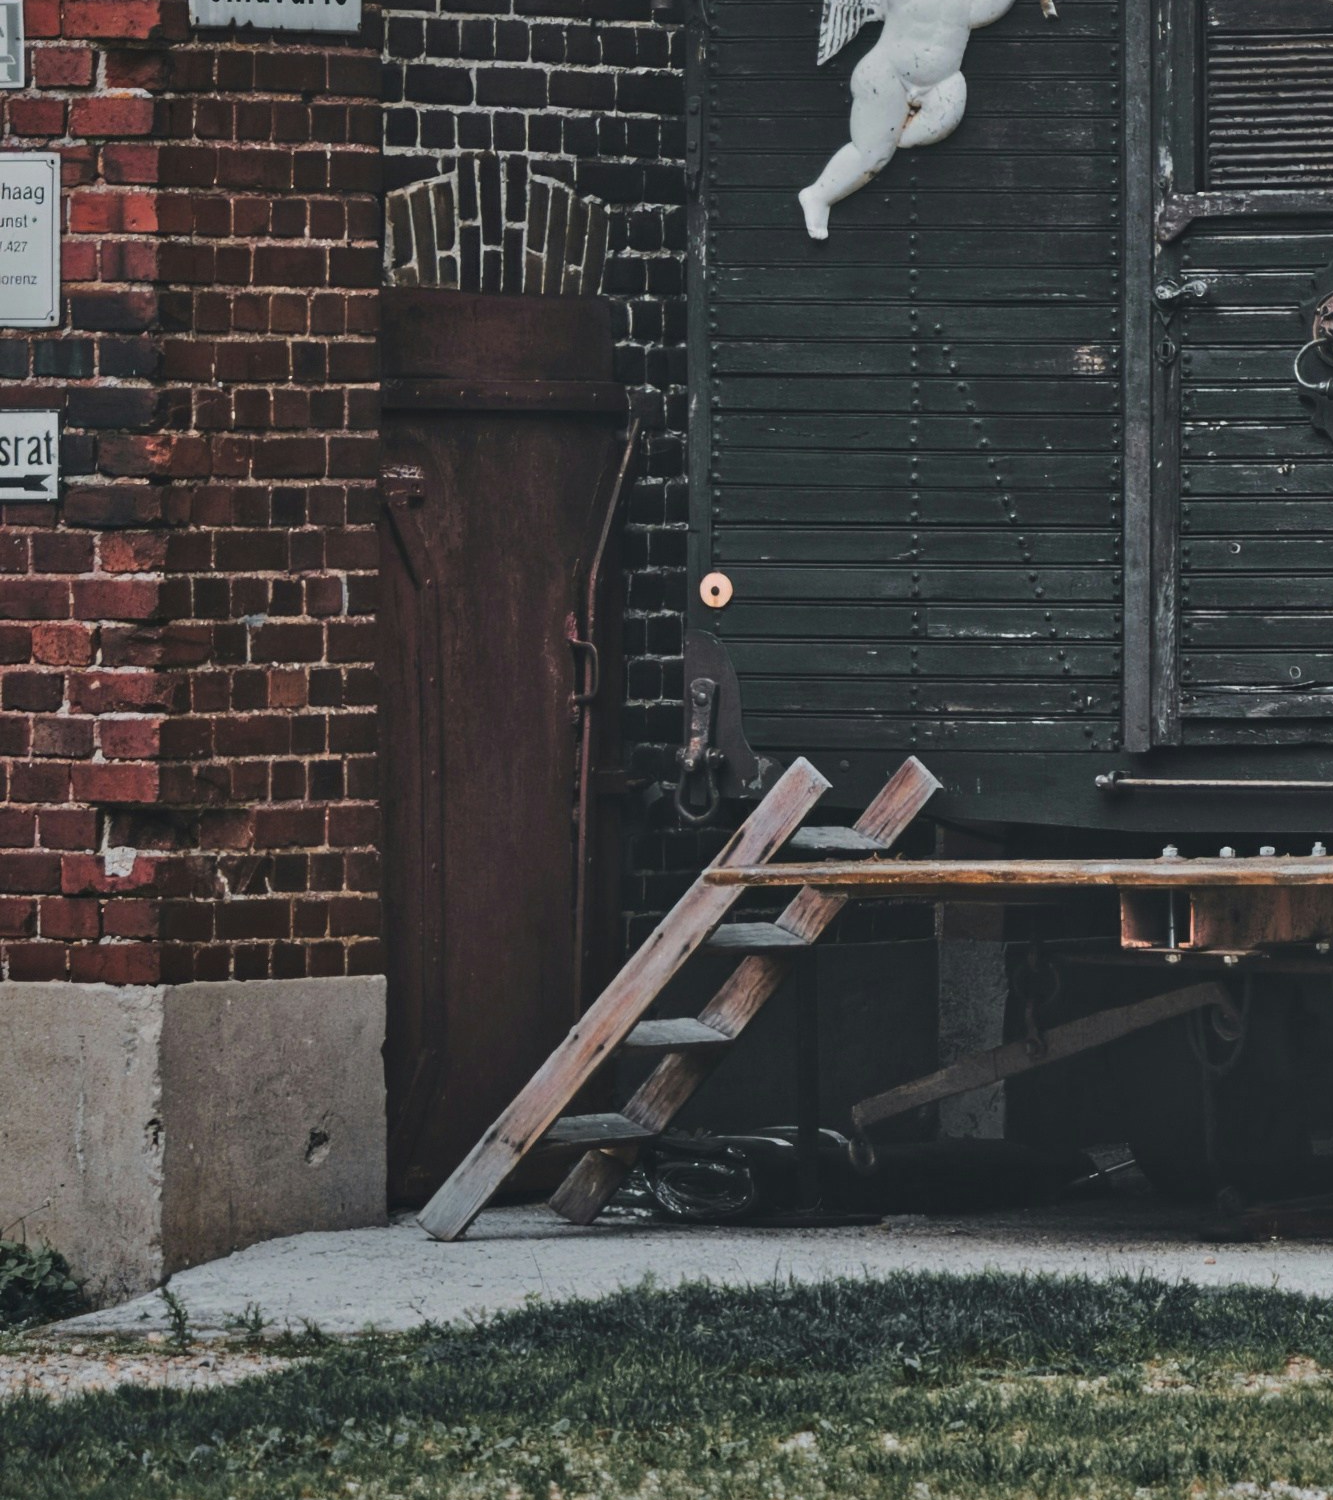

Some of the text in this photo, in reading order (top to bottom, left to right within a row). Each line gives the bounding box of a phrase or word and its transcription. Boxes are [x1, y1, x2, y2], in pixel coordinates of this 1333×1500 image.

[1, 182, 45, 205] haag
[0, 274, 38, 286] orenz
[0, 430, 53, 468] srat
